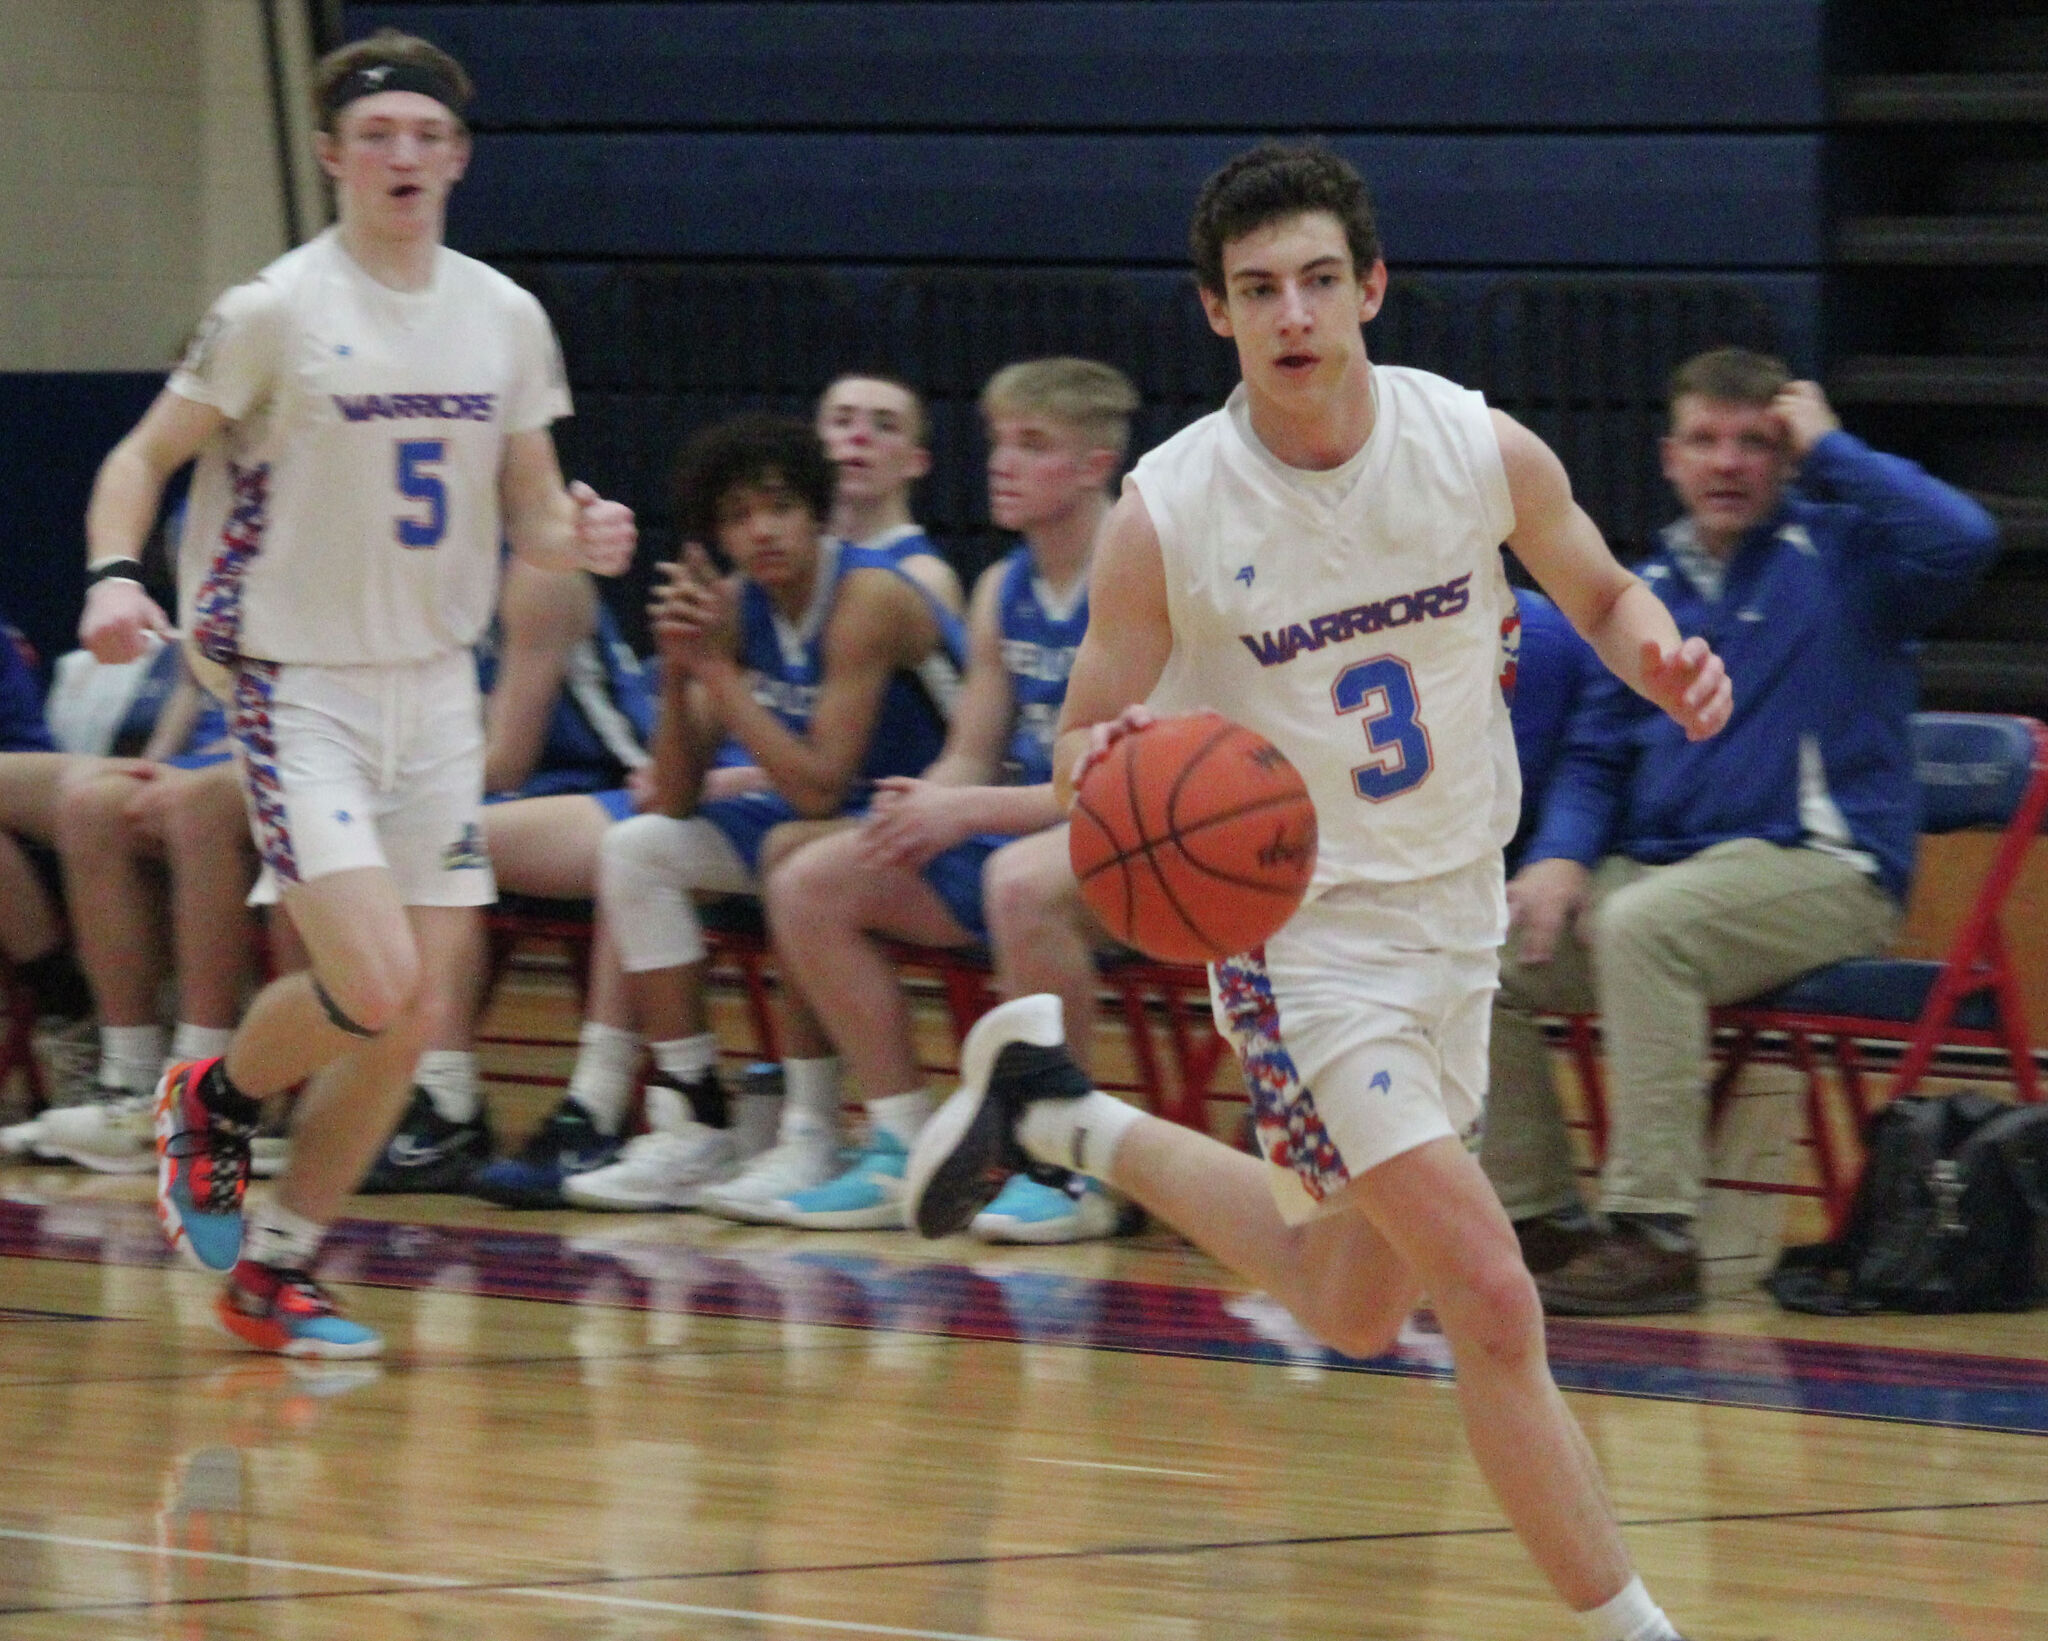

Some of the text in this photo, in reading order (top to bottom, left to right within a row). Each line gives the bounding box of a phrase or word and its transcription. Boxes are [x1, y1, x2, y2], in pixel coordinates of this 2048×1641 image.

[394, 436, 450, 551] 5
[1239, 571, 1473, 668] WARRIORS
[1330, 653, 1434, 804] 3
